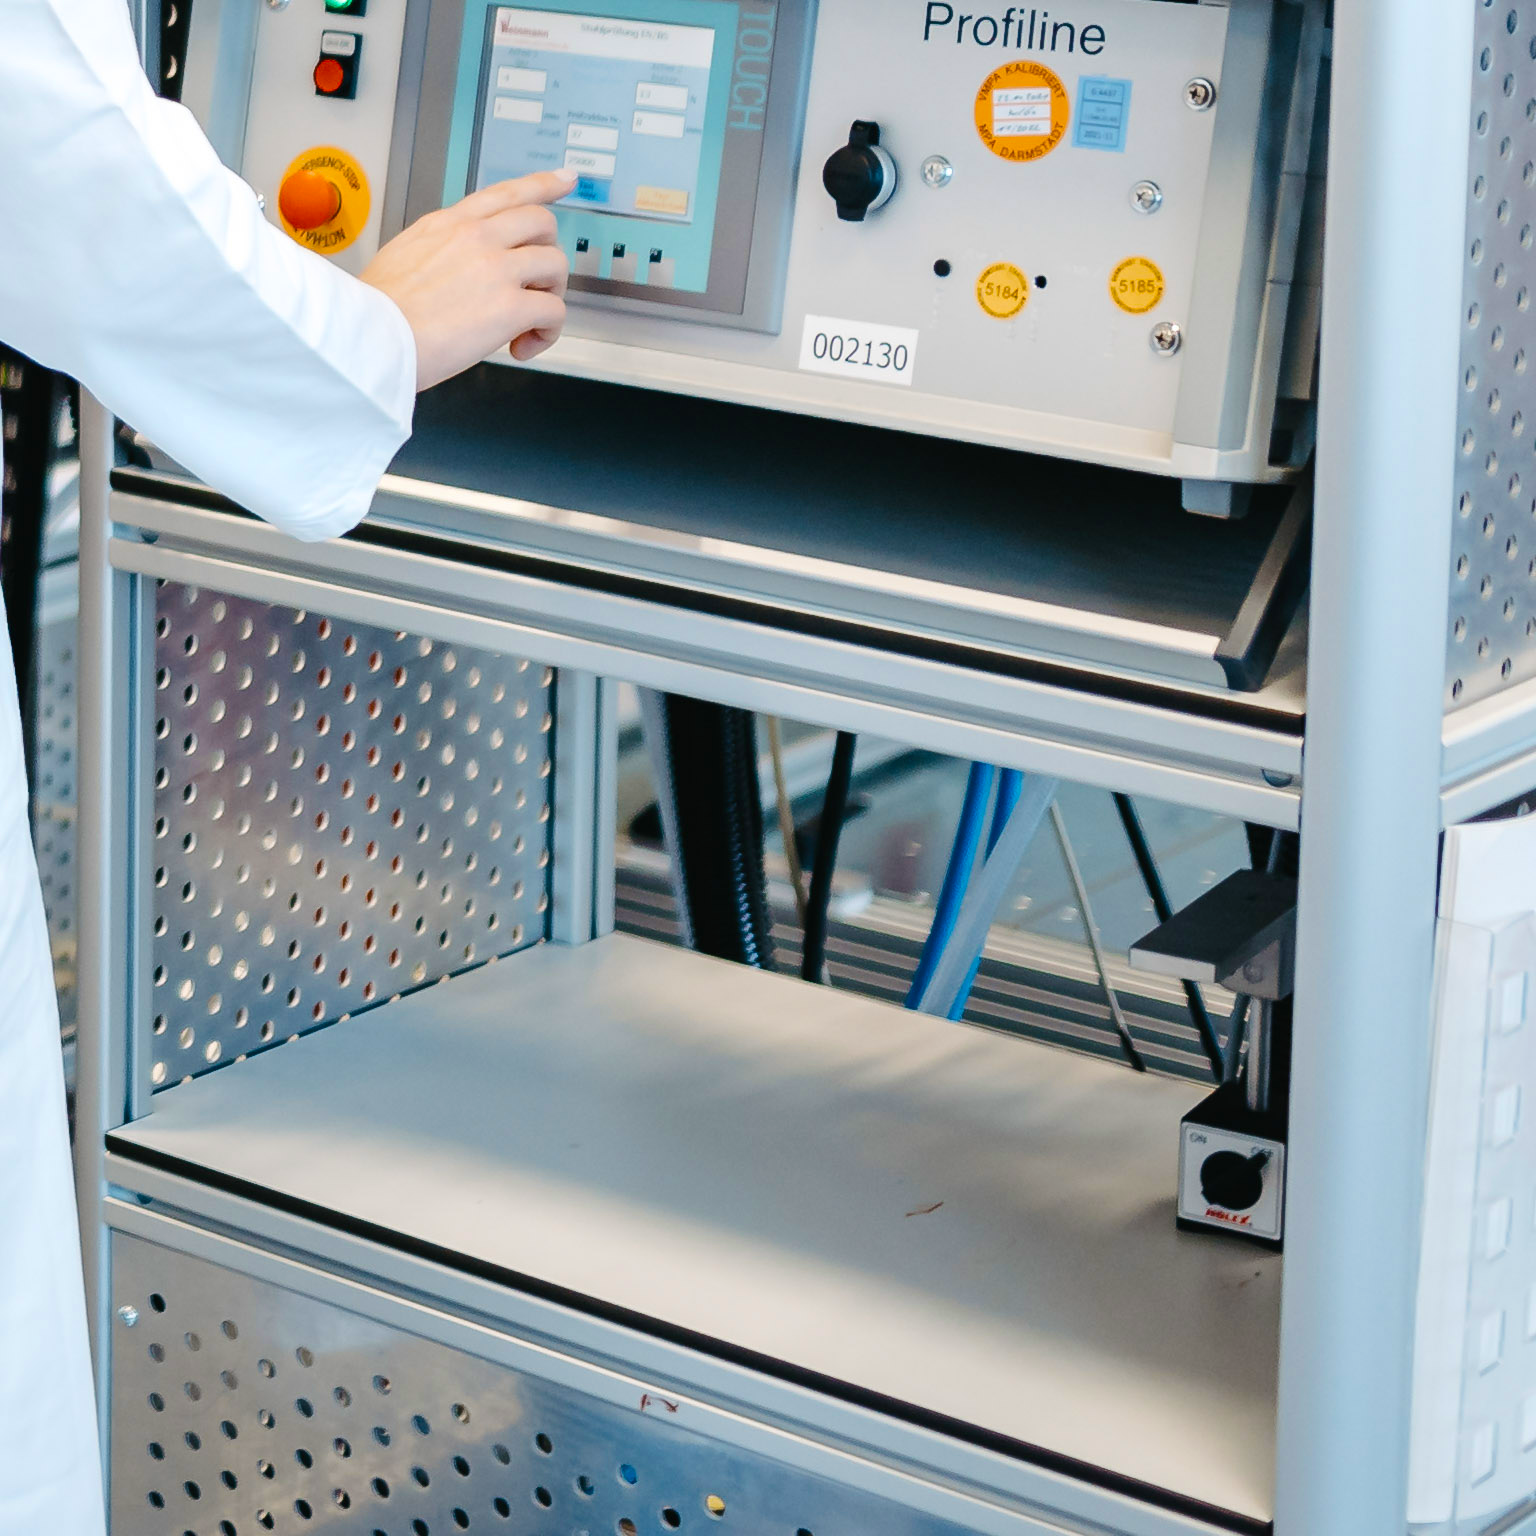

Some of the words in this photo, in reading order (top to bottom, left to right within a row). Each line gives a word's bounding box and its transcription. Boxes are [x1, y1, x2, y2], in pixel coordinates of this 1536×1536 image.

[923, 1, 1107, 56] Profiline
[729, 5, 776, 131] TOUCH
[978, 73, 1002, 102] VMPA
[1005, 63, 1066, 100] KALIBRIERT
[978, 122, 997, 149] MPA
[999, 121, 1064, 161] DARMSTADT
[985, 282, 1019, 301] 5184
[1119, 280, 1156, 294] 5185
[812, 332, 909, 371] 002130
